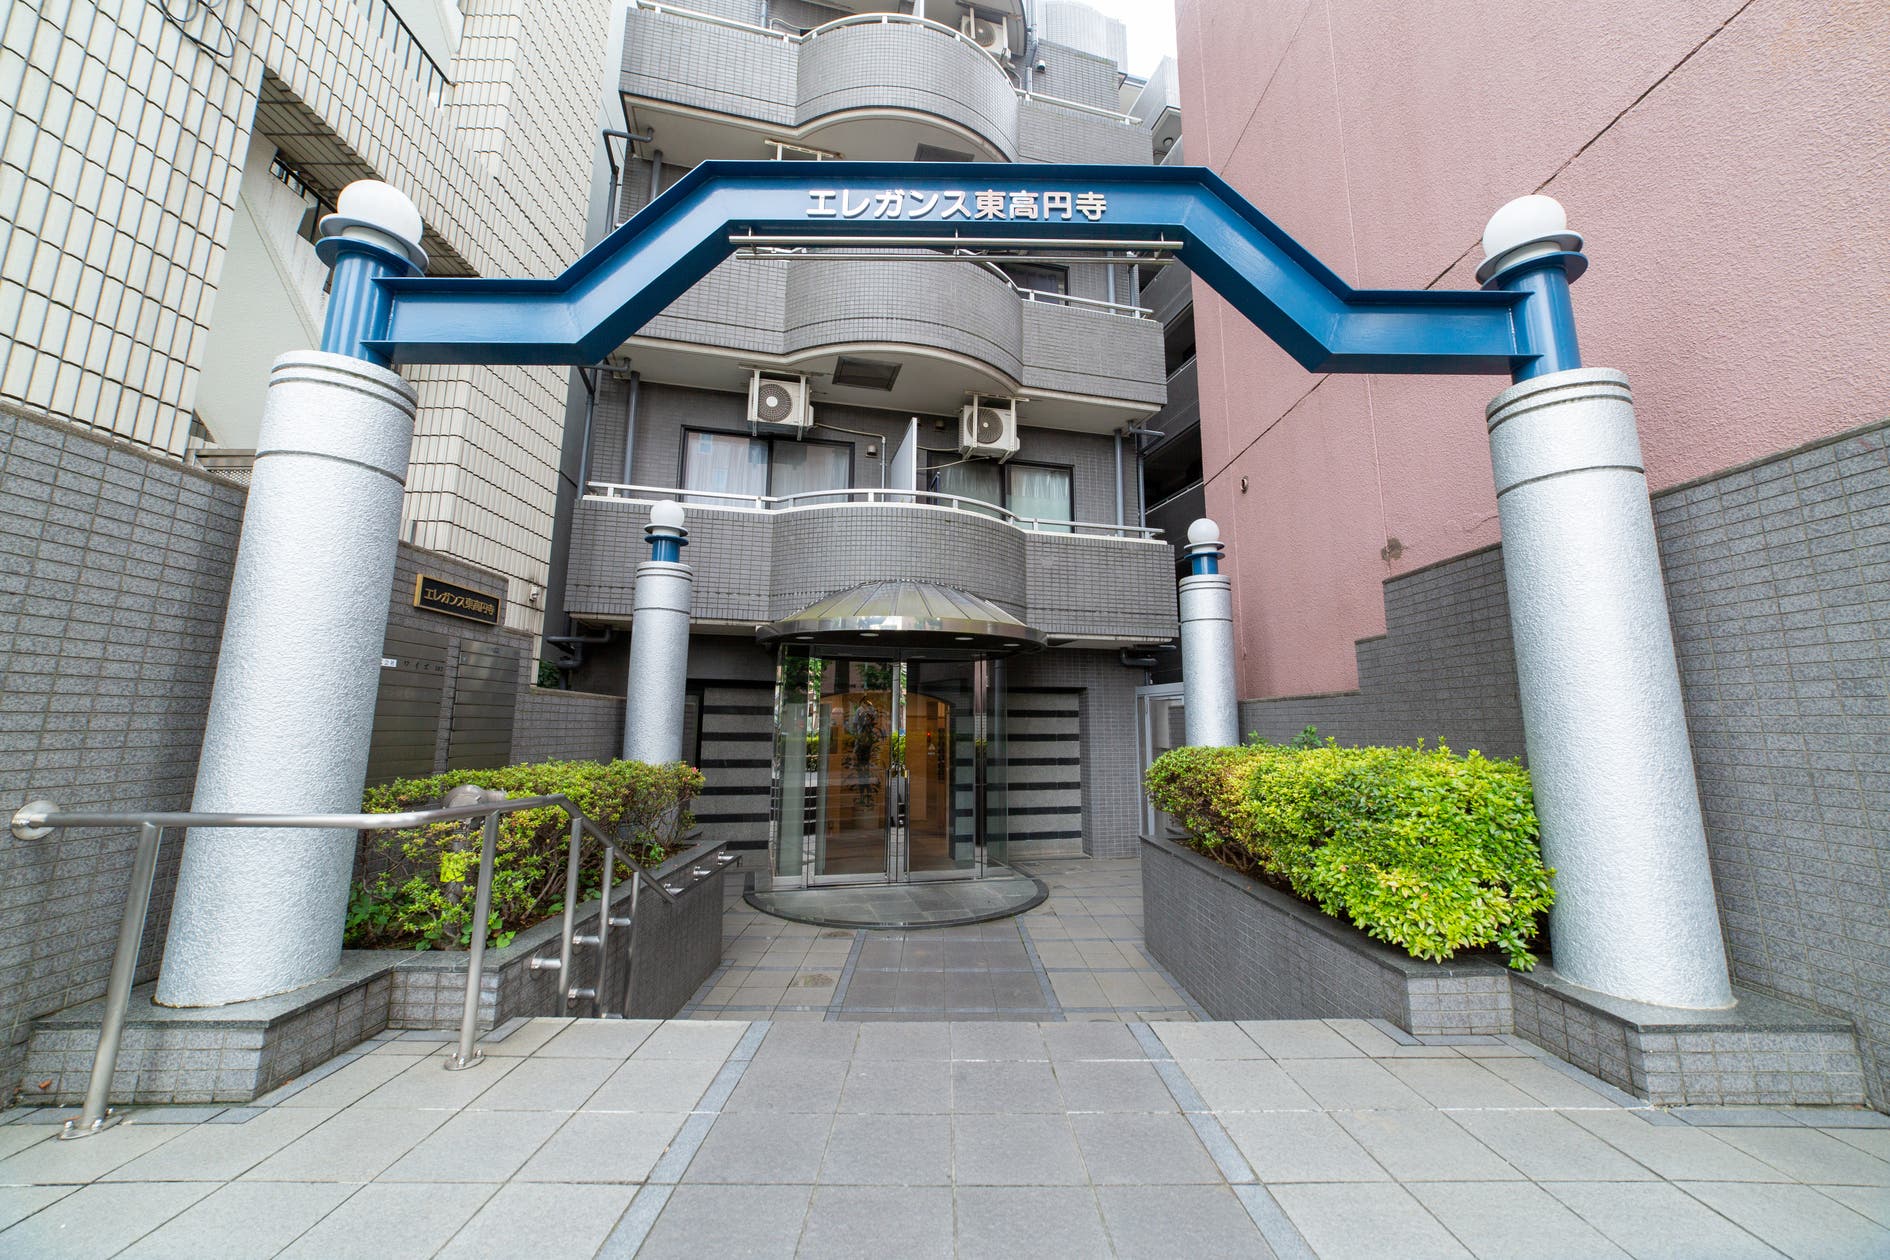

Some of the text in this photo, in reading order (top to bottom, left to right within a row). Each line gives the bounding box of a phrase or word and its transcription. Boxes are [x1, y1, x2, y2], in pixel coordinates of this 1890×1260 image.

[806, 189, 1107, 221] エレガンス東高円寺
[424, 588, 495, 615] エレガンス東高円寺
